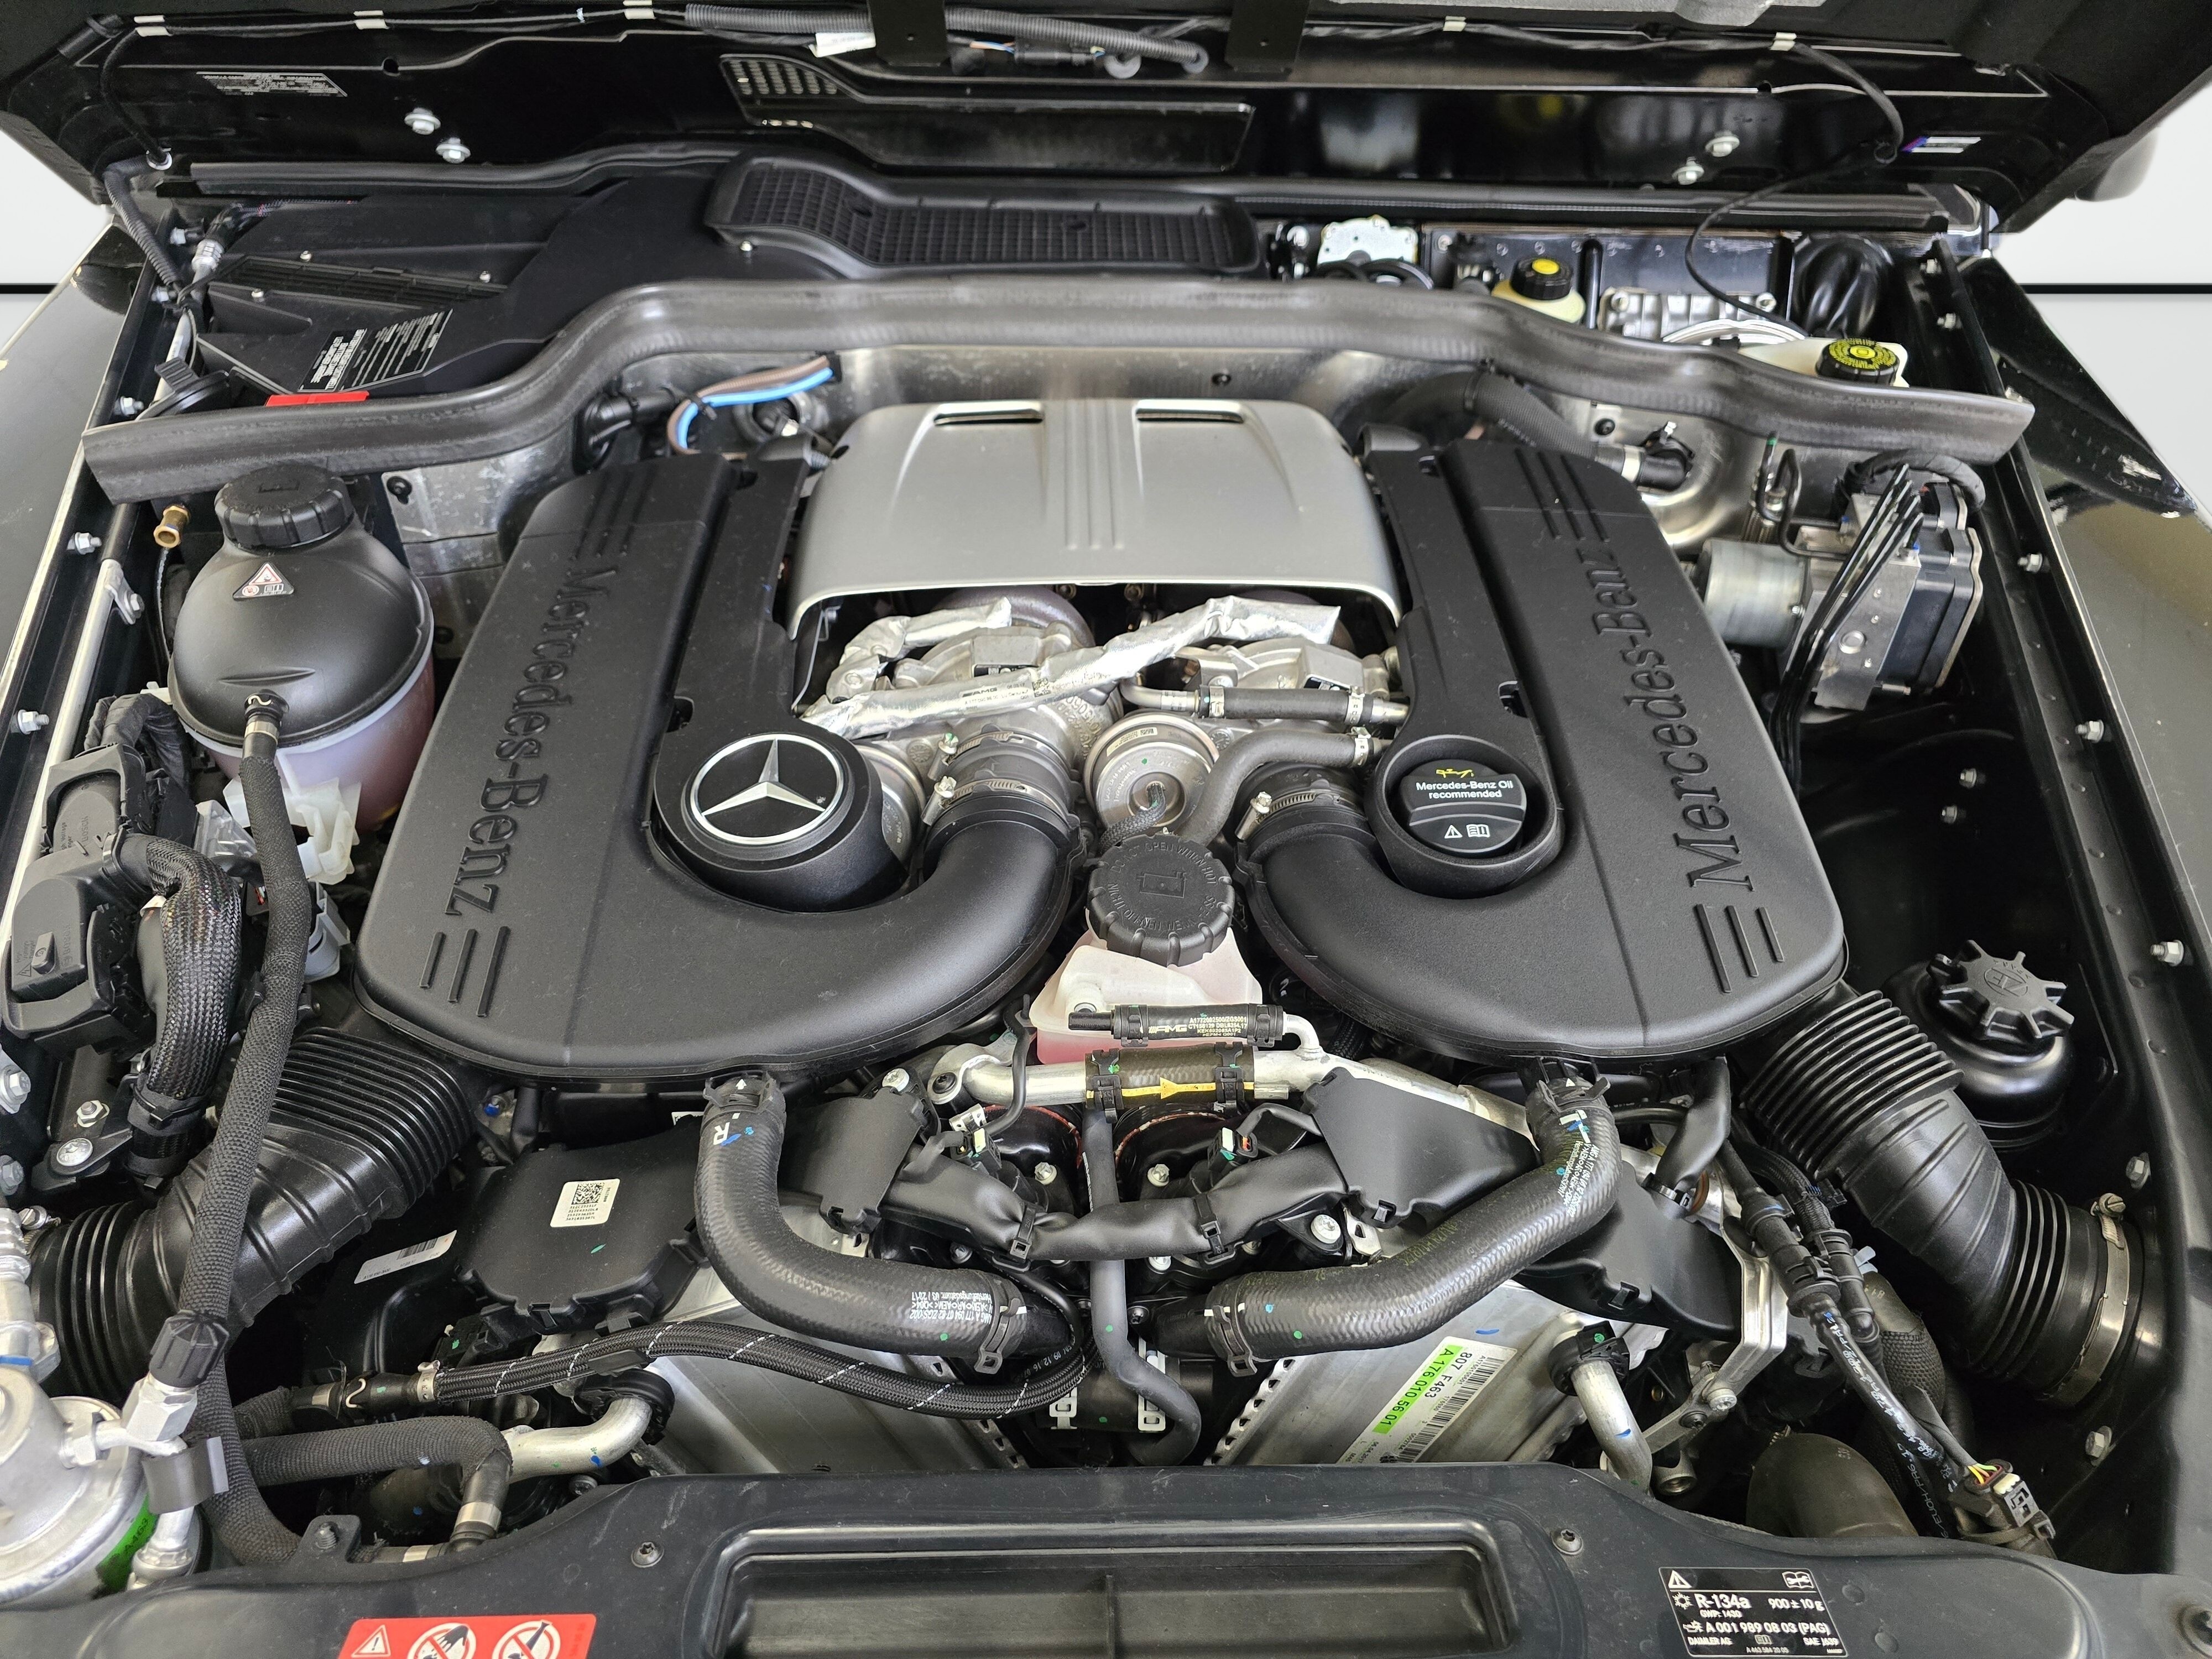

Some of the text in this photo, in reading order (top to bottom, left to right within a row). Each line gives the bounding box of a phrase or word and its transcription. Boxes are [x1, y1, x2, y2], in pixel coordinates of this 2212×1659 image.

[1575, 547, 1754, 891] Mercedes-Benz
[446, 565, 615, 915] Mercedes-Benz
[1416, 780, 1514, 790] Mercedes-Benz Oil
[1428, 790, 1503, 799] recommended
[1145, 842, 1173, 852] OPEN
[1156, 1024, 1187, 1033] AMG
[713, 1121, 731, 1145] R
[1422, 1360, 1445, 1378] 176
[1425, 1352, 1473, 1398] 807 F463
[1404, 1380, 1427, 1398] 010
[1392, 1400, 1409, 1412] 56
[1380, 1414, 1397, 1426] 01
[1694, 1593, 1752, 1609] R-134a
[1767, 1598, 1791, 1609] 900
[1801, 1599, 1815, 1609] 10
[1814, 1600, 1825, 1611] g
[1705, 1623, 1830, 1635] A 001 989 08 03 (PAG)
[1687, 1636, 1720, 1645] DAIMLER
[1803, 1637, 1821, 1646] SAE
